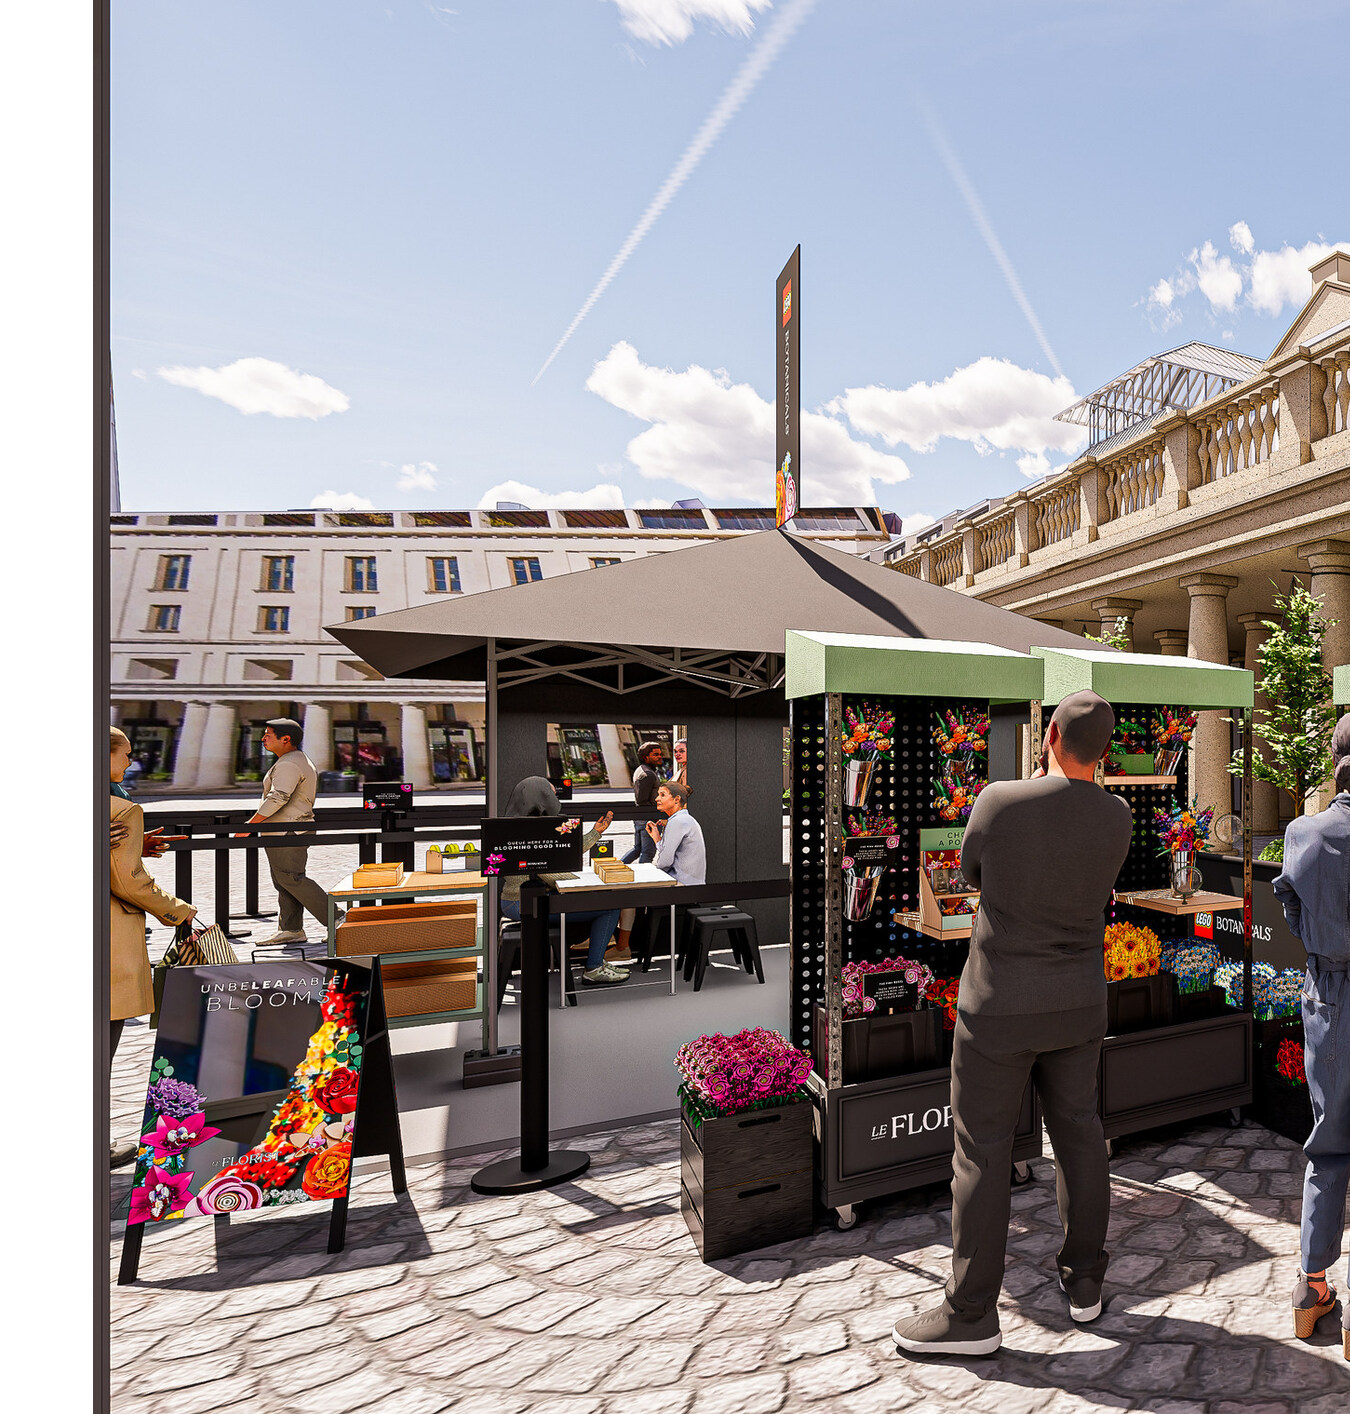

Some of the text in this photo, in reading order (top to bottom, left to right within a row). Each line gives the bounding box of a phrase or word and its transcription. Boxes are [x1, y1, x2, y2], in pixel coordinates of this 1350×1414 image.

[1195, 911, 1273, 942] LEGO BOTANALS
[201, 975, 341, 994] UNBELEAFABLE
[207, 988, 332, 1012] BLOOMS
[871, 1124, 888, 1138] LE
[221, 1150, 283, 1168] FLORIST
